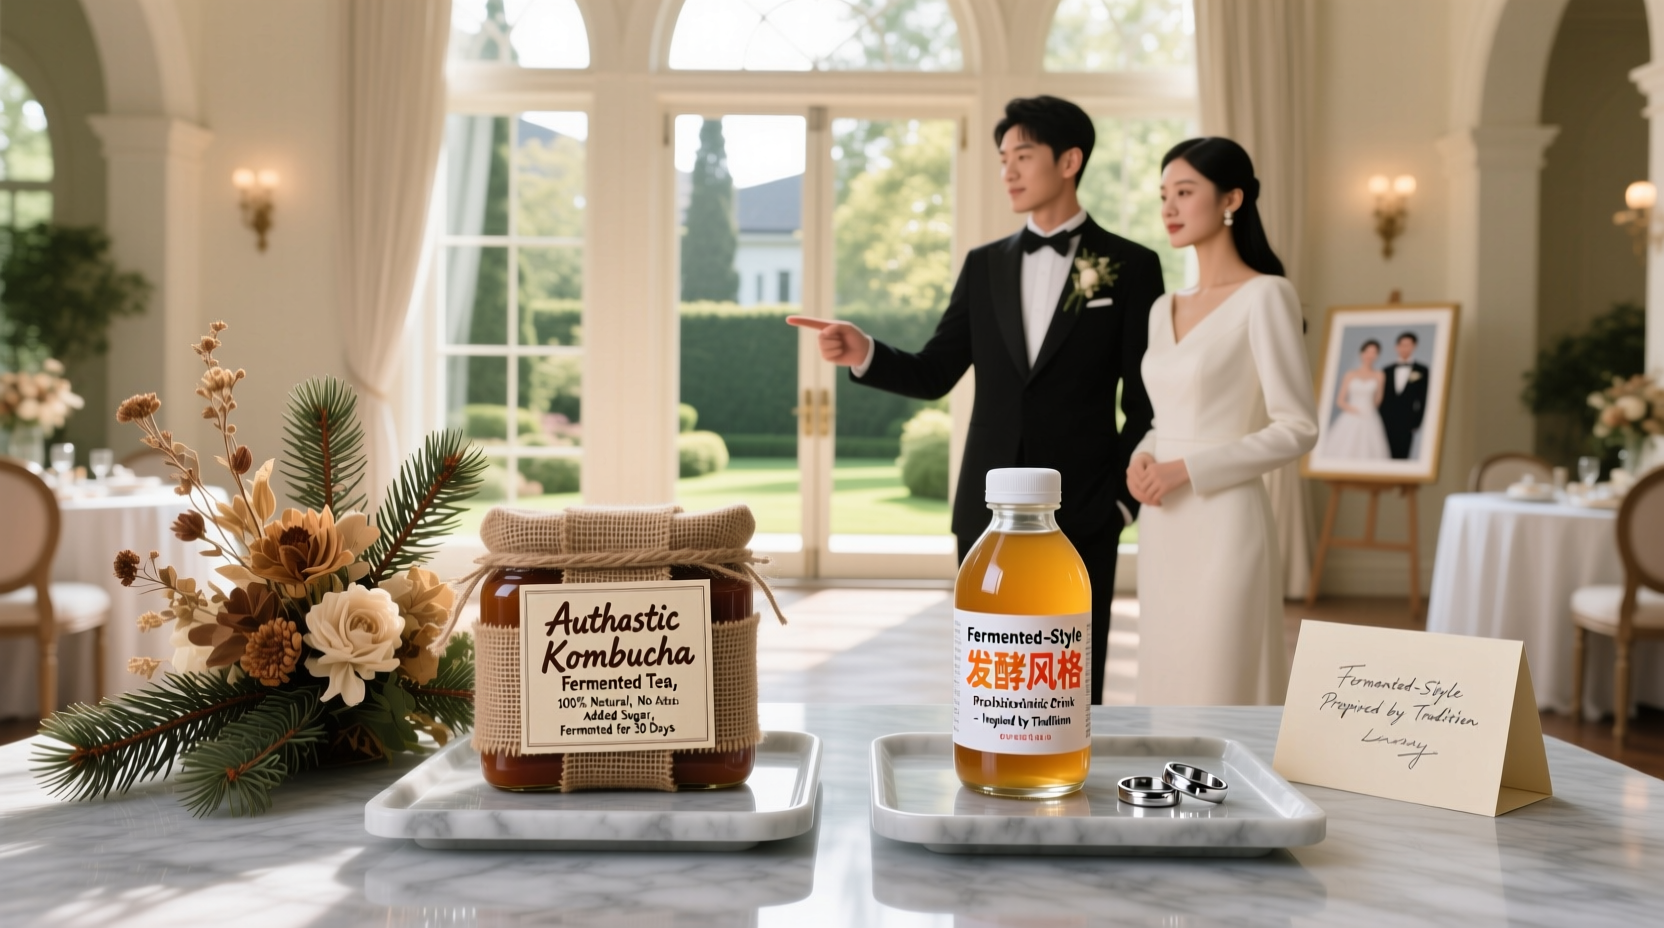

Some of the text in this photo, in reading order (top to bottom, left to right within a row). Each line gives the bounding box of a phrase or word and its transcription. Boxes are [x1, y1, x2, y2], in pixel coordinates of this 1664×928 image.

[544, 601, 680, 636] Authastic
[541, 635, 695, 674] Kombucha
[966, 649, 1083, 691] 发酵风格
[562, 673, 677, 691] Fermented Tea,
[637, 695, 652, 706] No
[583, 710, 617, 721] Added
[1387, 702, 1405, 725] by
[649, 722, 675, 737] Days
